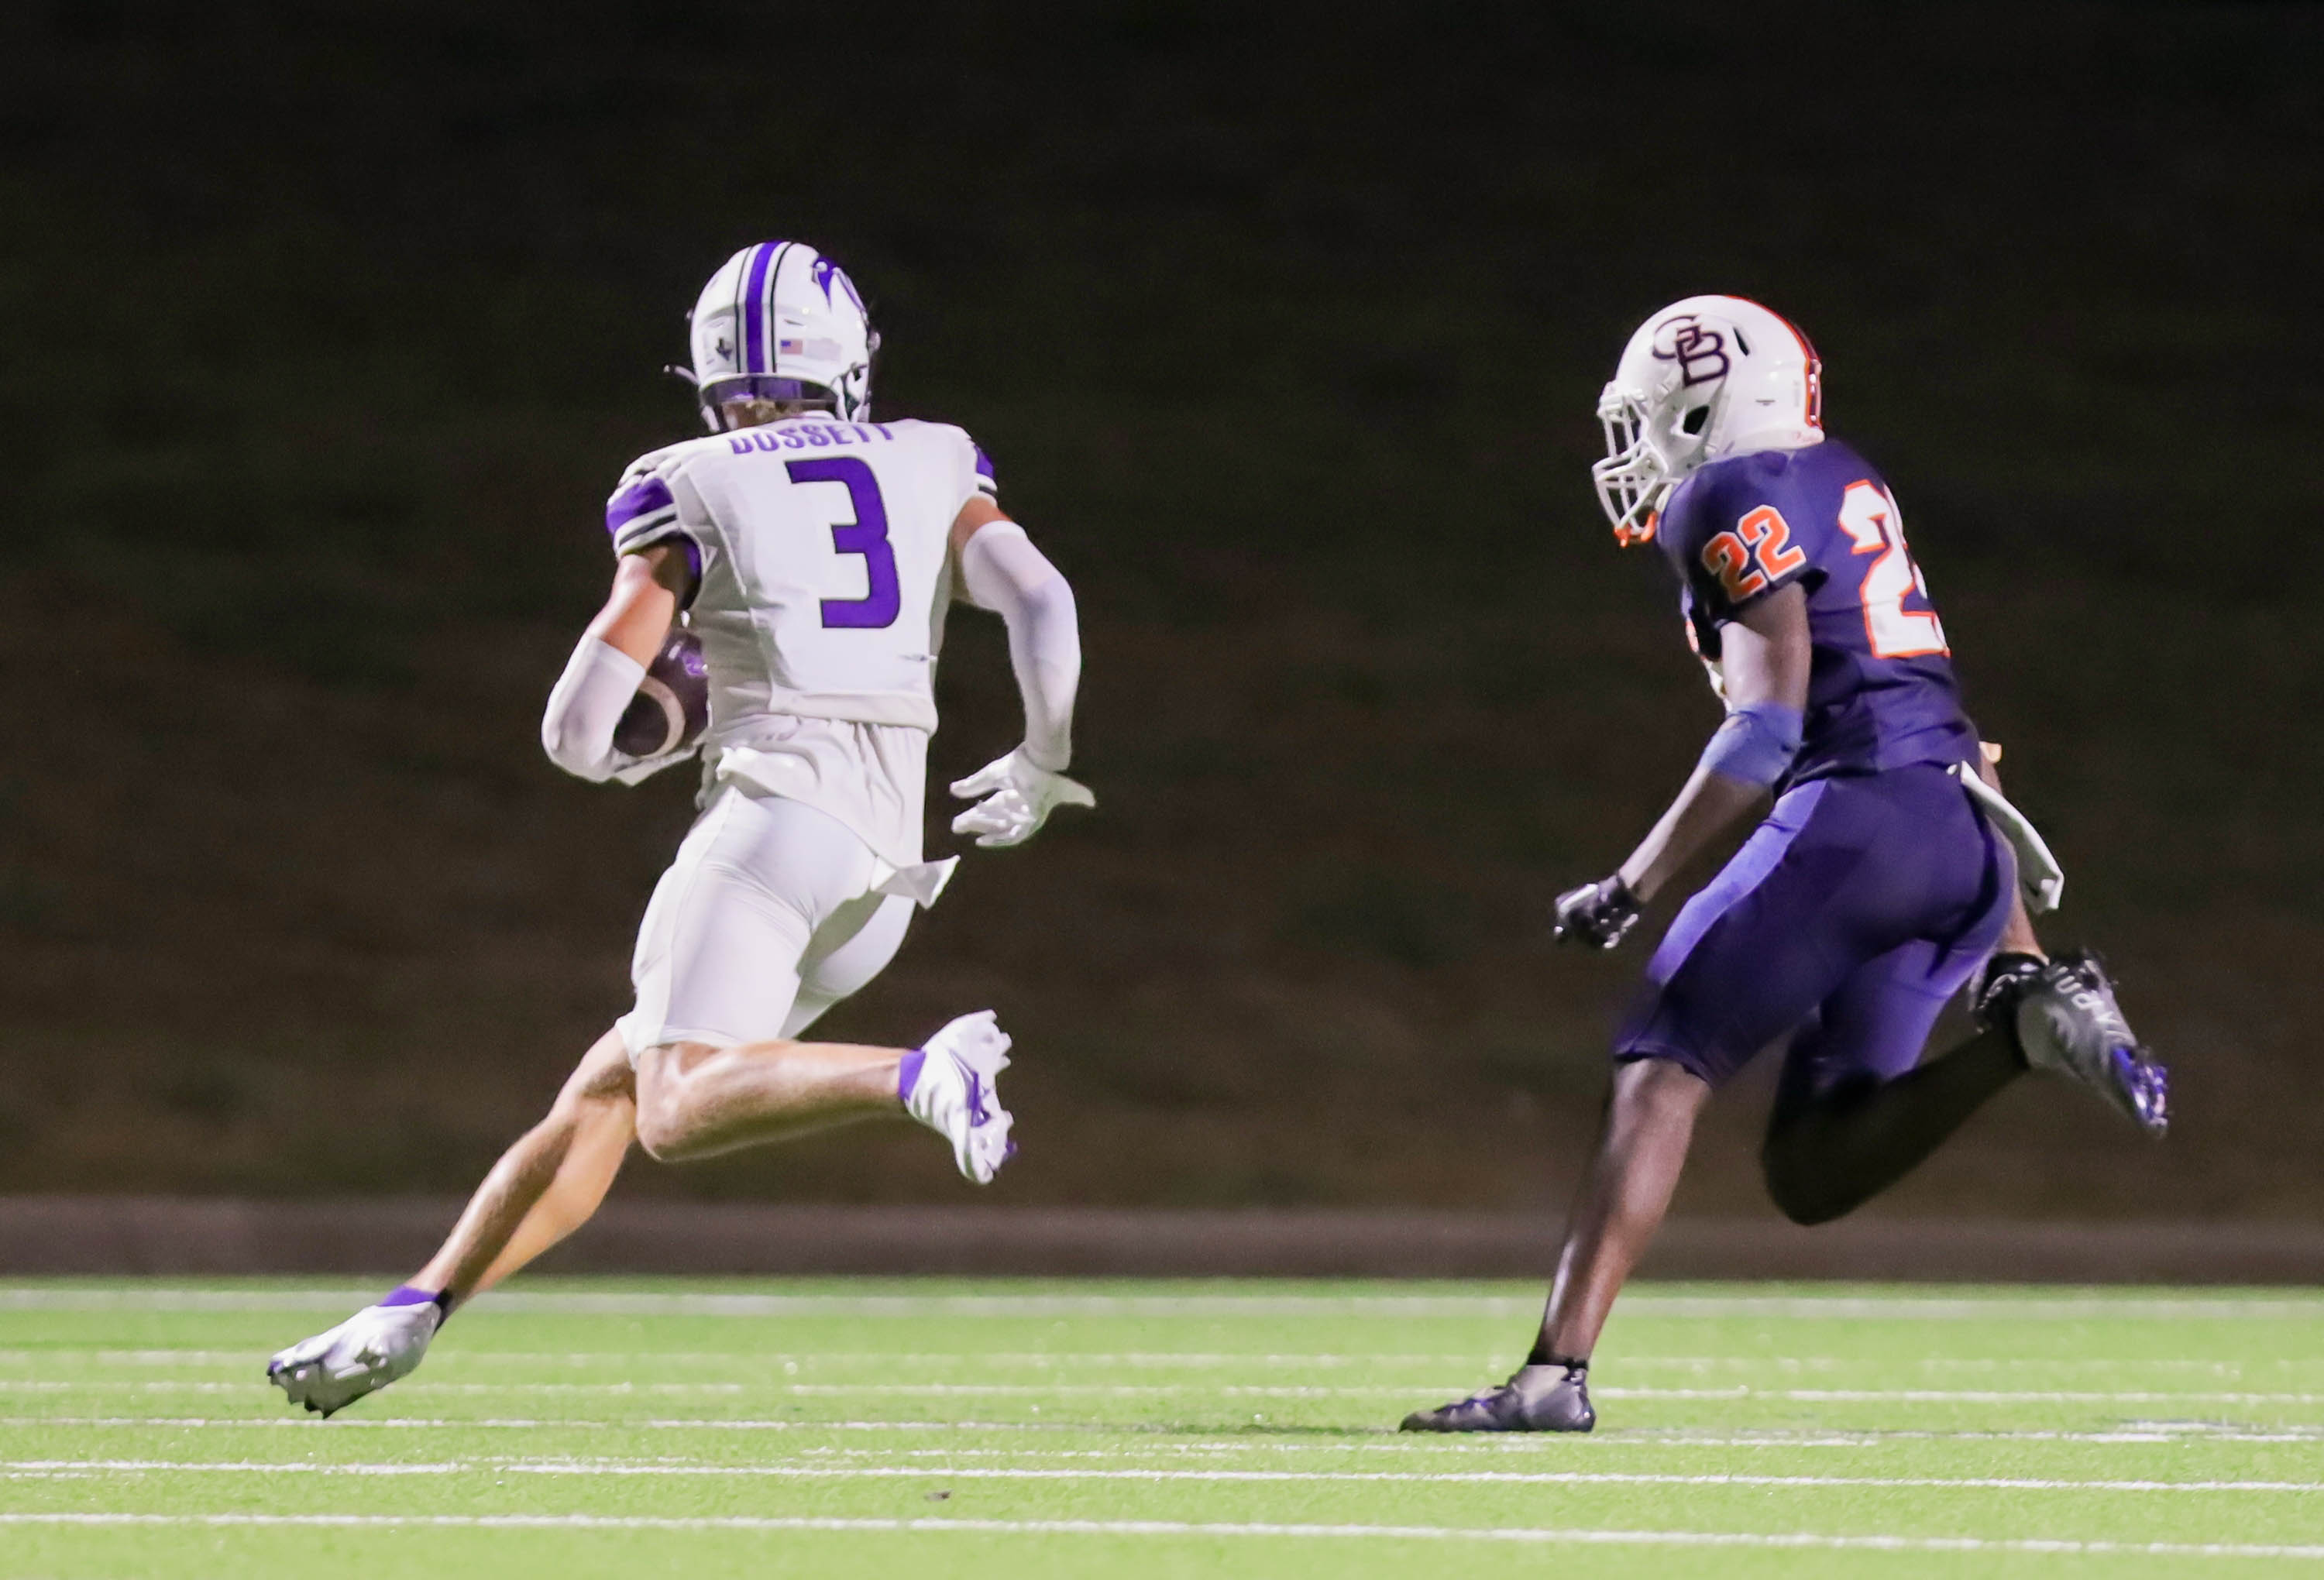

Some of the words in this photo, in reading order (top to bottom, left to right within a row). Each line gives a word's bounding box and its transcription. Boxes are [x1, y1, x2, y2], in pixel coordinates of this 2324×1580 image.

[784, 455, 901, 628] 3
[1701, 504, 1807, 604] 22
[1838, 479, 1951, 660] 2
